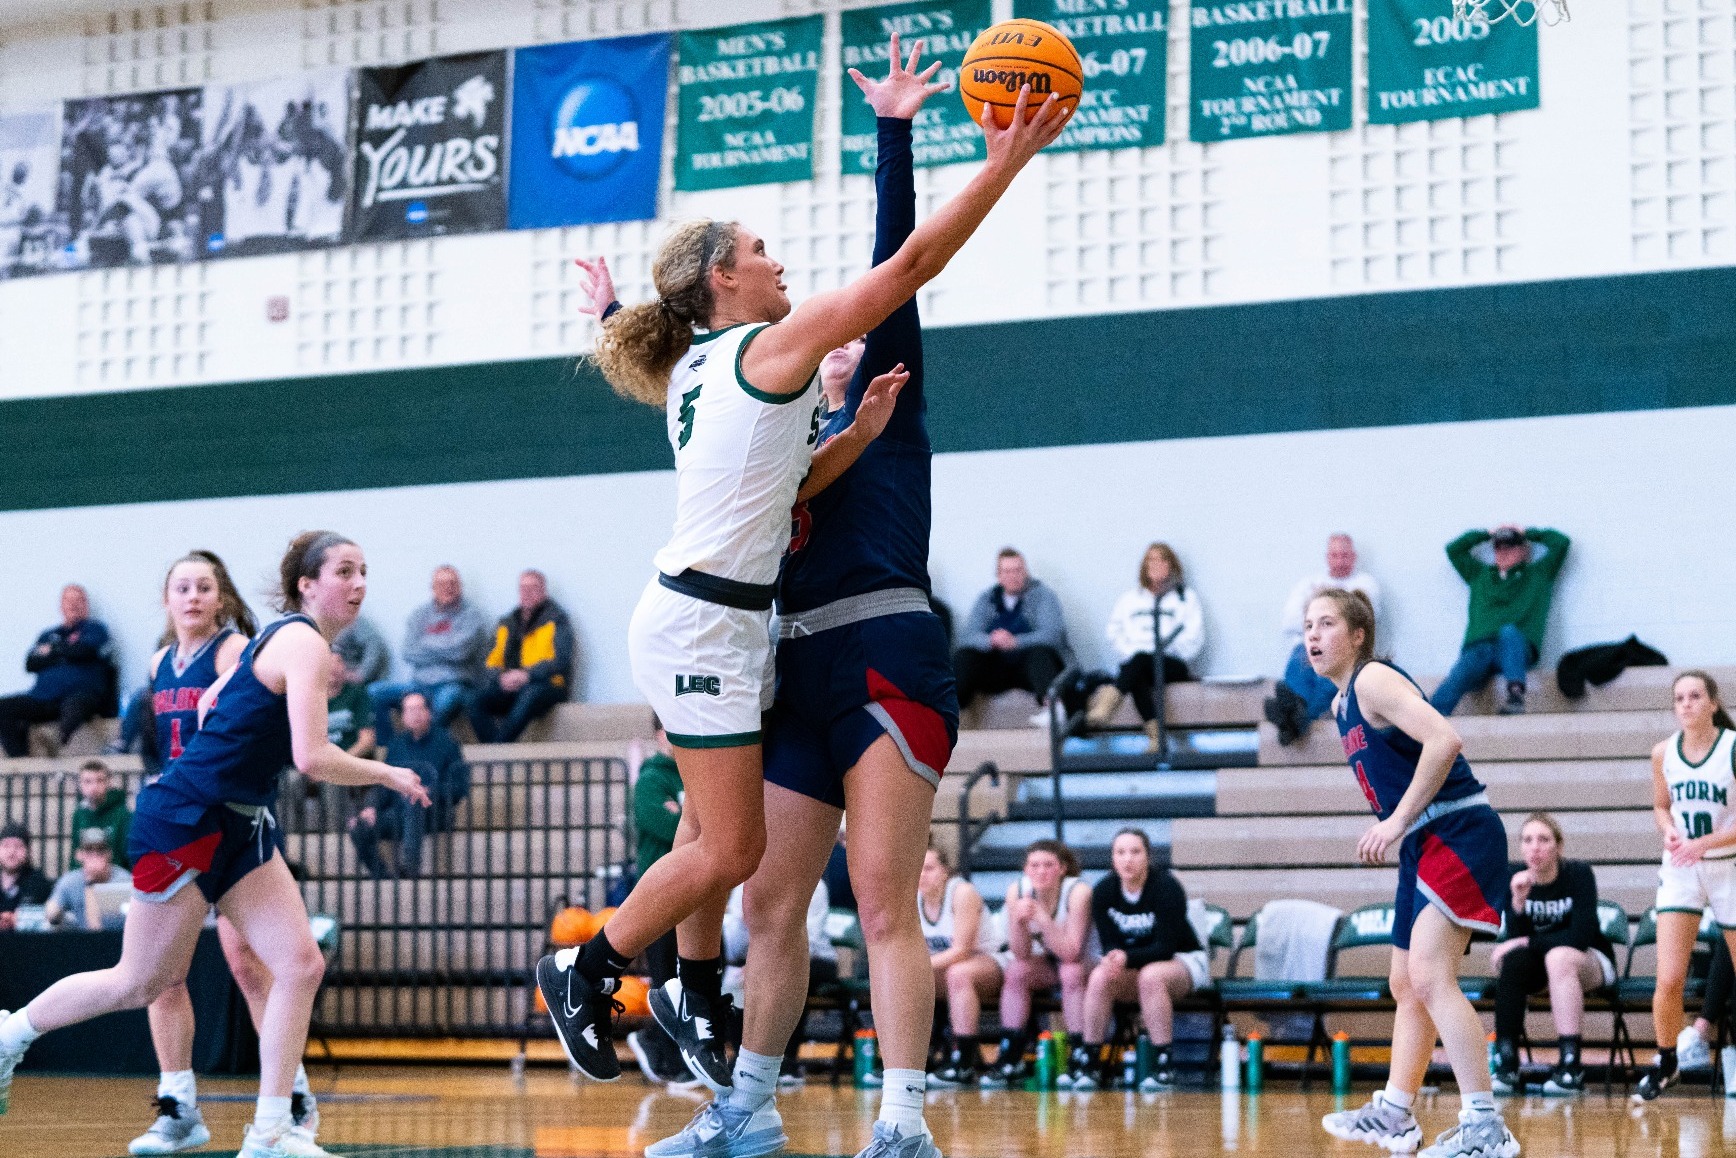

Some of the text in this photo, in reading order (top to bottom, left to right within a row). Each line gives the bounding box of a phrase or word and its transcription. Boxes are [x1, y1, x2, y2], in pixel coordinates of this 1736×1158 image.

[1049, 11, 1166, 39] KETBALL
[1412, 15, 1491, 47] 2005
[1080, 47, 1148, 78] 6-07
[1211, 30, 1331, 68] 2006-07
[680, 50, 819, 85] BASKETBALL
[973, 67, 1053, 94] Wilson
[1423, 63, 1484, 87] ECAC
[698, 86, 806, 122] 2005-06
[1202, 87, 1343, 118] TOURNAMENT
[1377, 76, 1531, 110] TOURNAMENT
[364, 95, 448, 131] MAKE
[551, 120, 641, 159] NCAA
[360, 127, 500, 209] YOURS
[678, 383, 703, 451] 5
[1671, 780, 1728, 807] TORM
[1682, 811, 1714, 840] 10
[1524, 896, 1573, 917] TORM
